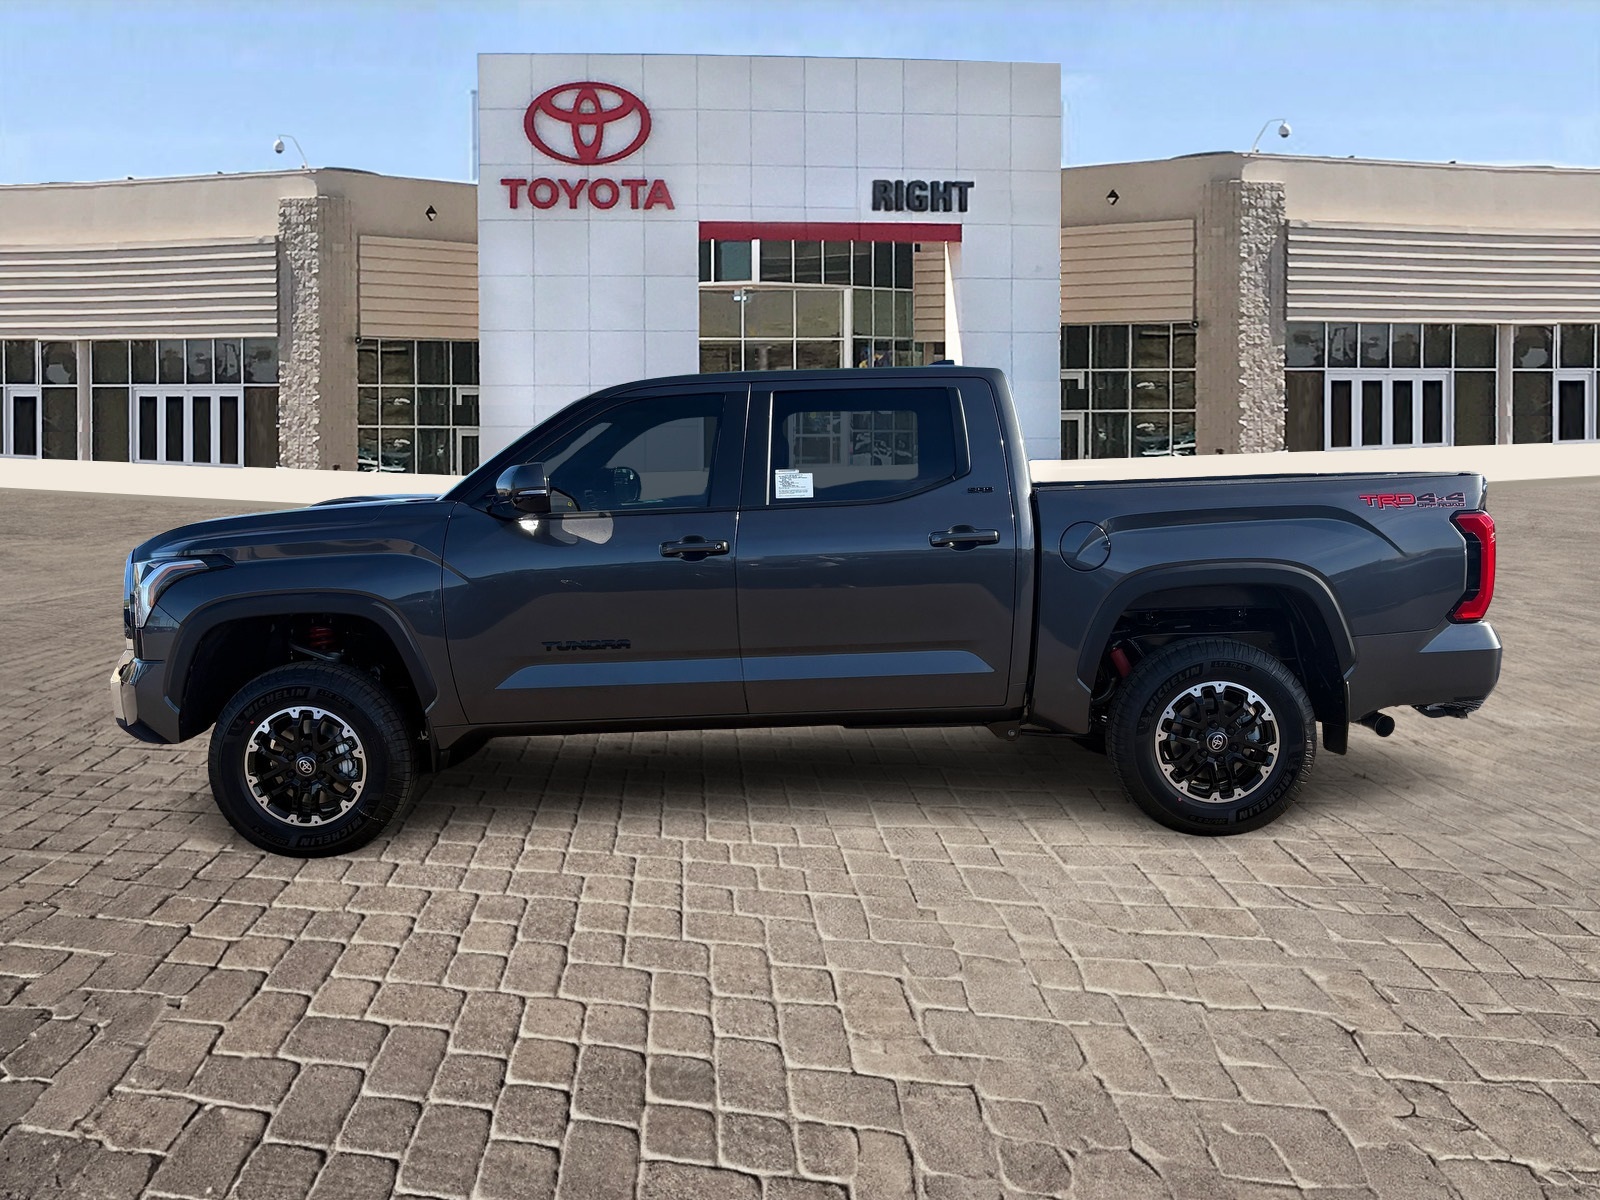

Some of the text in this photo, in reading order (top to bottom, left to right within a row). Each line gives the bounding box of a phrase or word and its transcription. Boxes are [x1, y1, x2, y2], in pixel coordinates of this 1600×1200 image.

[500, 177, 675, 210] TOYOTA
[872, 179, 975, 213] RIGHT
[1359, 492, 1466, 510] TRD 4x4
[541, 638, 631, 652] TUNDRA
[243, 686, 306, 719] MICHELIN
[1145, 663, 1200, 714] MICHELIN
[1238, 770, 1293, 821] MICHELIN
[299, 816, 365, 847] MICHELIN
